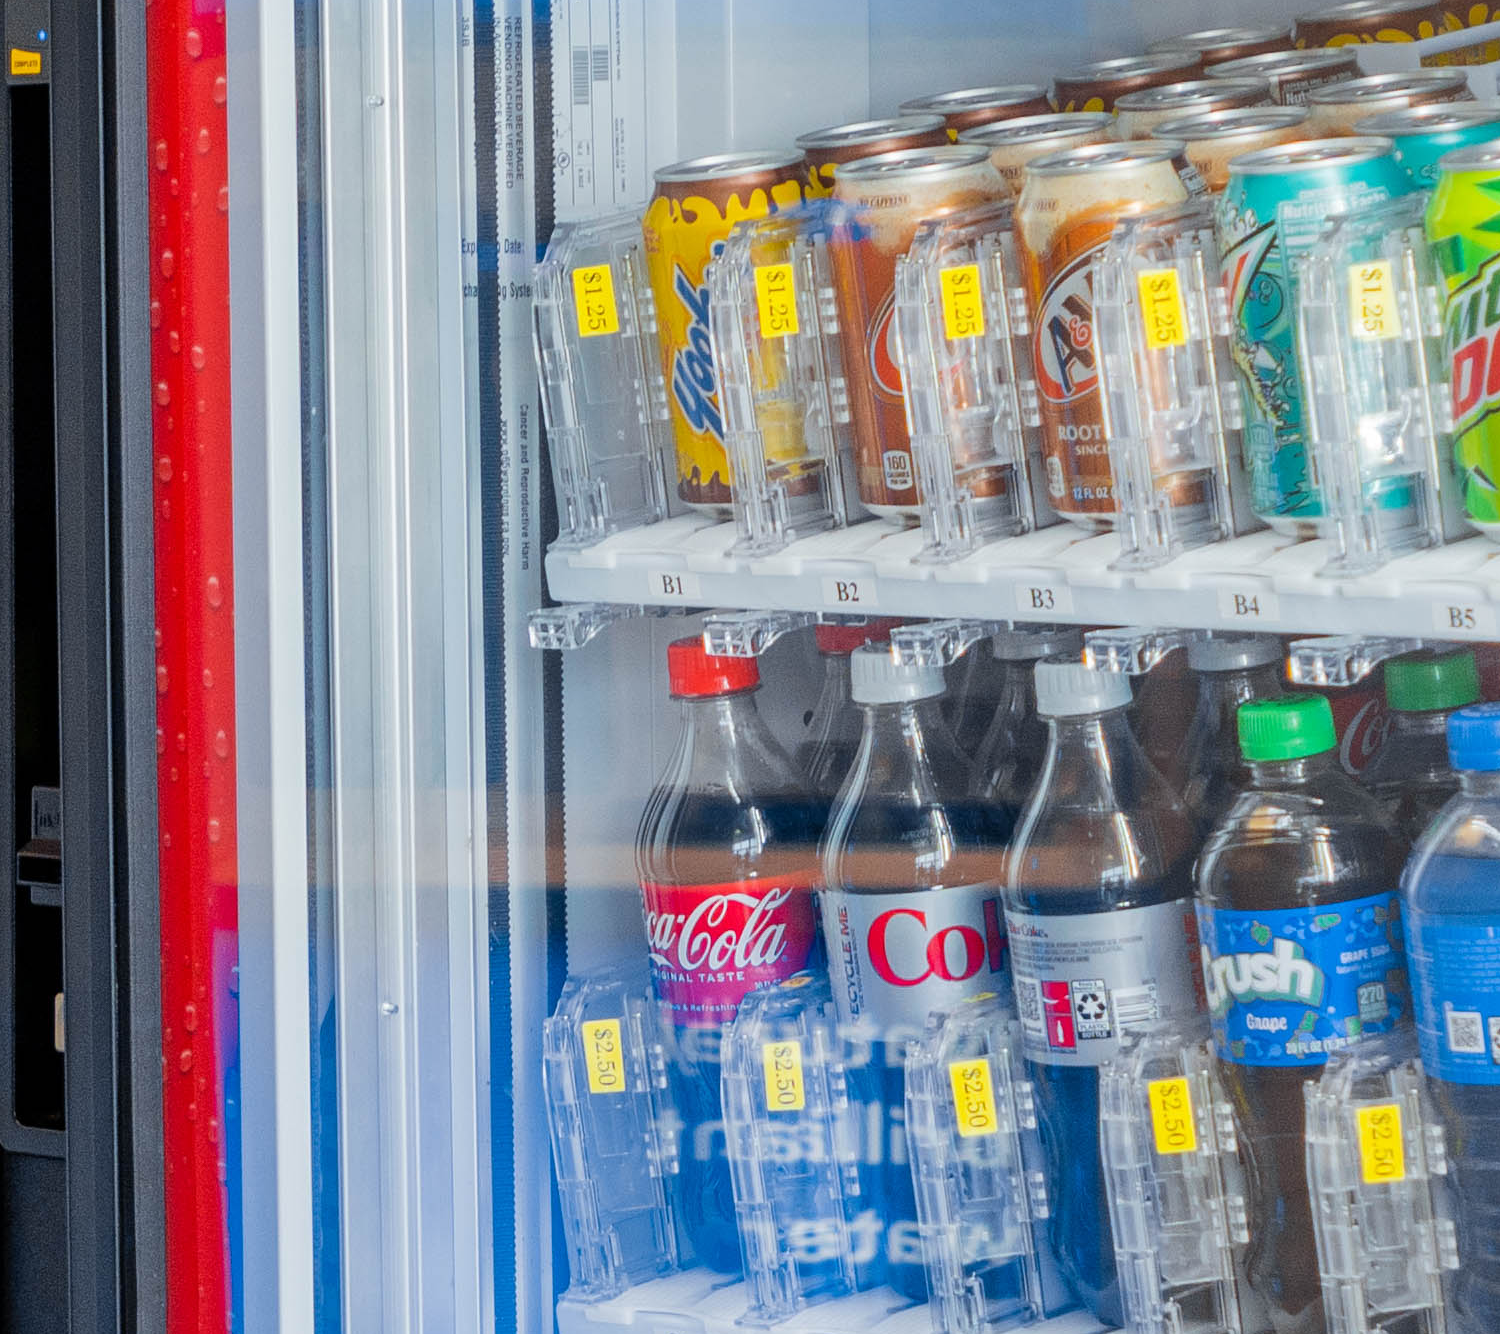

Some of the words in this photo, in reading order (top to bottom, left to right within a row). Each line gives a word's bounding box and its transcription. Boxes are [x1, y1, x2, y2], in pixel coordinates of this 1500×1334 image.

[504, 16, 513, 71] VENDING
[513, 16, 524, 112] REFRIGERATED
[504, 74, 514, 130] MACHINE
[505, 132, 514, 189] VERIFIED
[514, 114, 525, 181] BEVERAGE
[581, 270, 610, 333] $1.25
[761, 270, 790, 333] $1.25
[948, 271, 977, 334] $1.25
[1150, 276, 1179, 343] $1.25
[1361, 268, 1389, 333] $1.25
[1057, 424, 1102, 441] ROOT
[886, 455, 906, 470] 160
[662, 573, 684, 596] B1
[837, 581, 859, 603] B2
[1031, 586, 1054, 609] B3
[1234, 593, 1260, 616] B4
[1449, 606, 1476, 629] B5
[646, 887, 793, 971] ca-Cola
[698, 971, 746, 983] TASTE
[1359, 985, 1384, 1004] 270
[1246, 1012, 1288, 1033] Grape
[593, 1027, 619, 1088] $2.50
[773, 1044, 798, 1106] $2.50
[961, 1066, 989, 1129] $2.50
[1158, 1084, 1186, 1149] $2.50
[1367, 1110, 1396, 1178] $2.50
